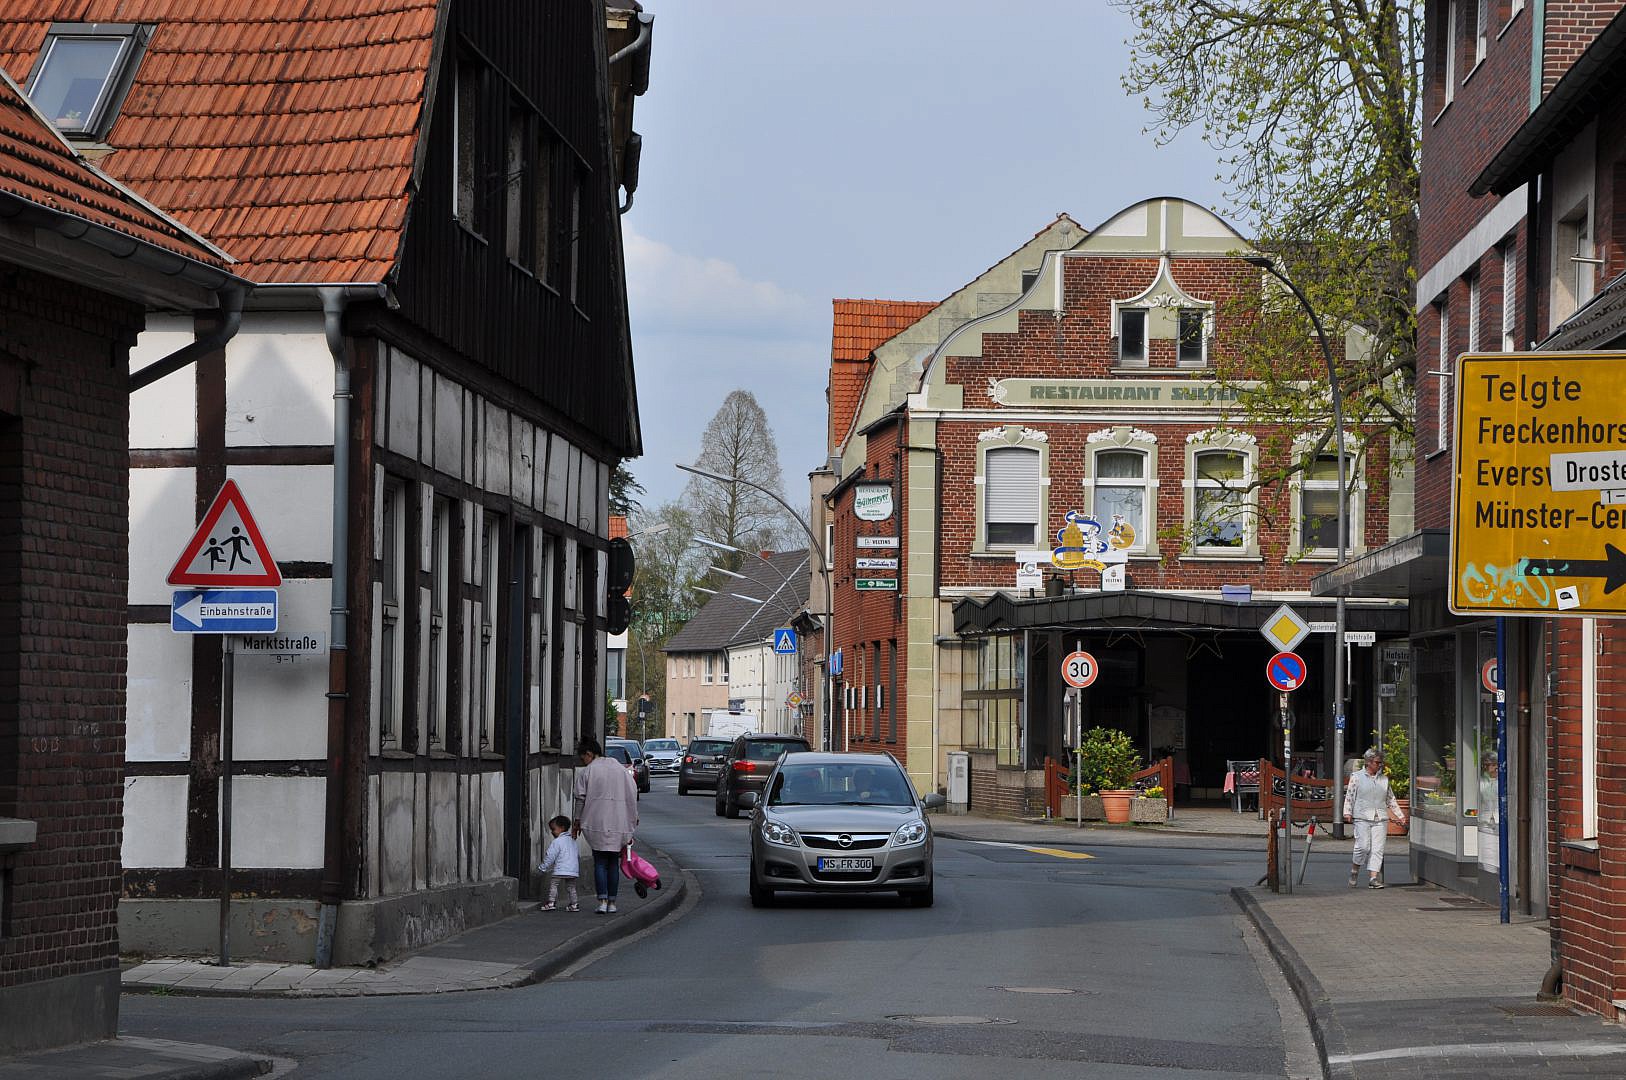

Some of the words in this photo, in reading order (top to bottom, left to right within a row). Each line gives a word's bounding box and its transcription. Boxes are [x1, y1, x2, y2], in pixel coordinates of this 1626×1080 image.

[1030, 385, 1161, 400] RESTAURANT
[1480, 374, 1581, 409] Telgte
[1478, 416, 1626, 444] Freckenhors
[200, 606, 272, 616] Einbahnstraße
[243, 636, 317, 650] Marktstraße
[1070, 662, 1090, 678] 30
[823, 859, 836, 869] MS
[841, 859, 853, 869] FR
[855, 859, 872, 869] 300
